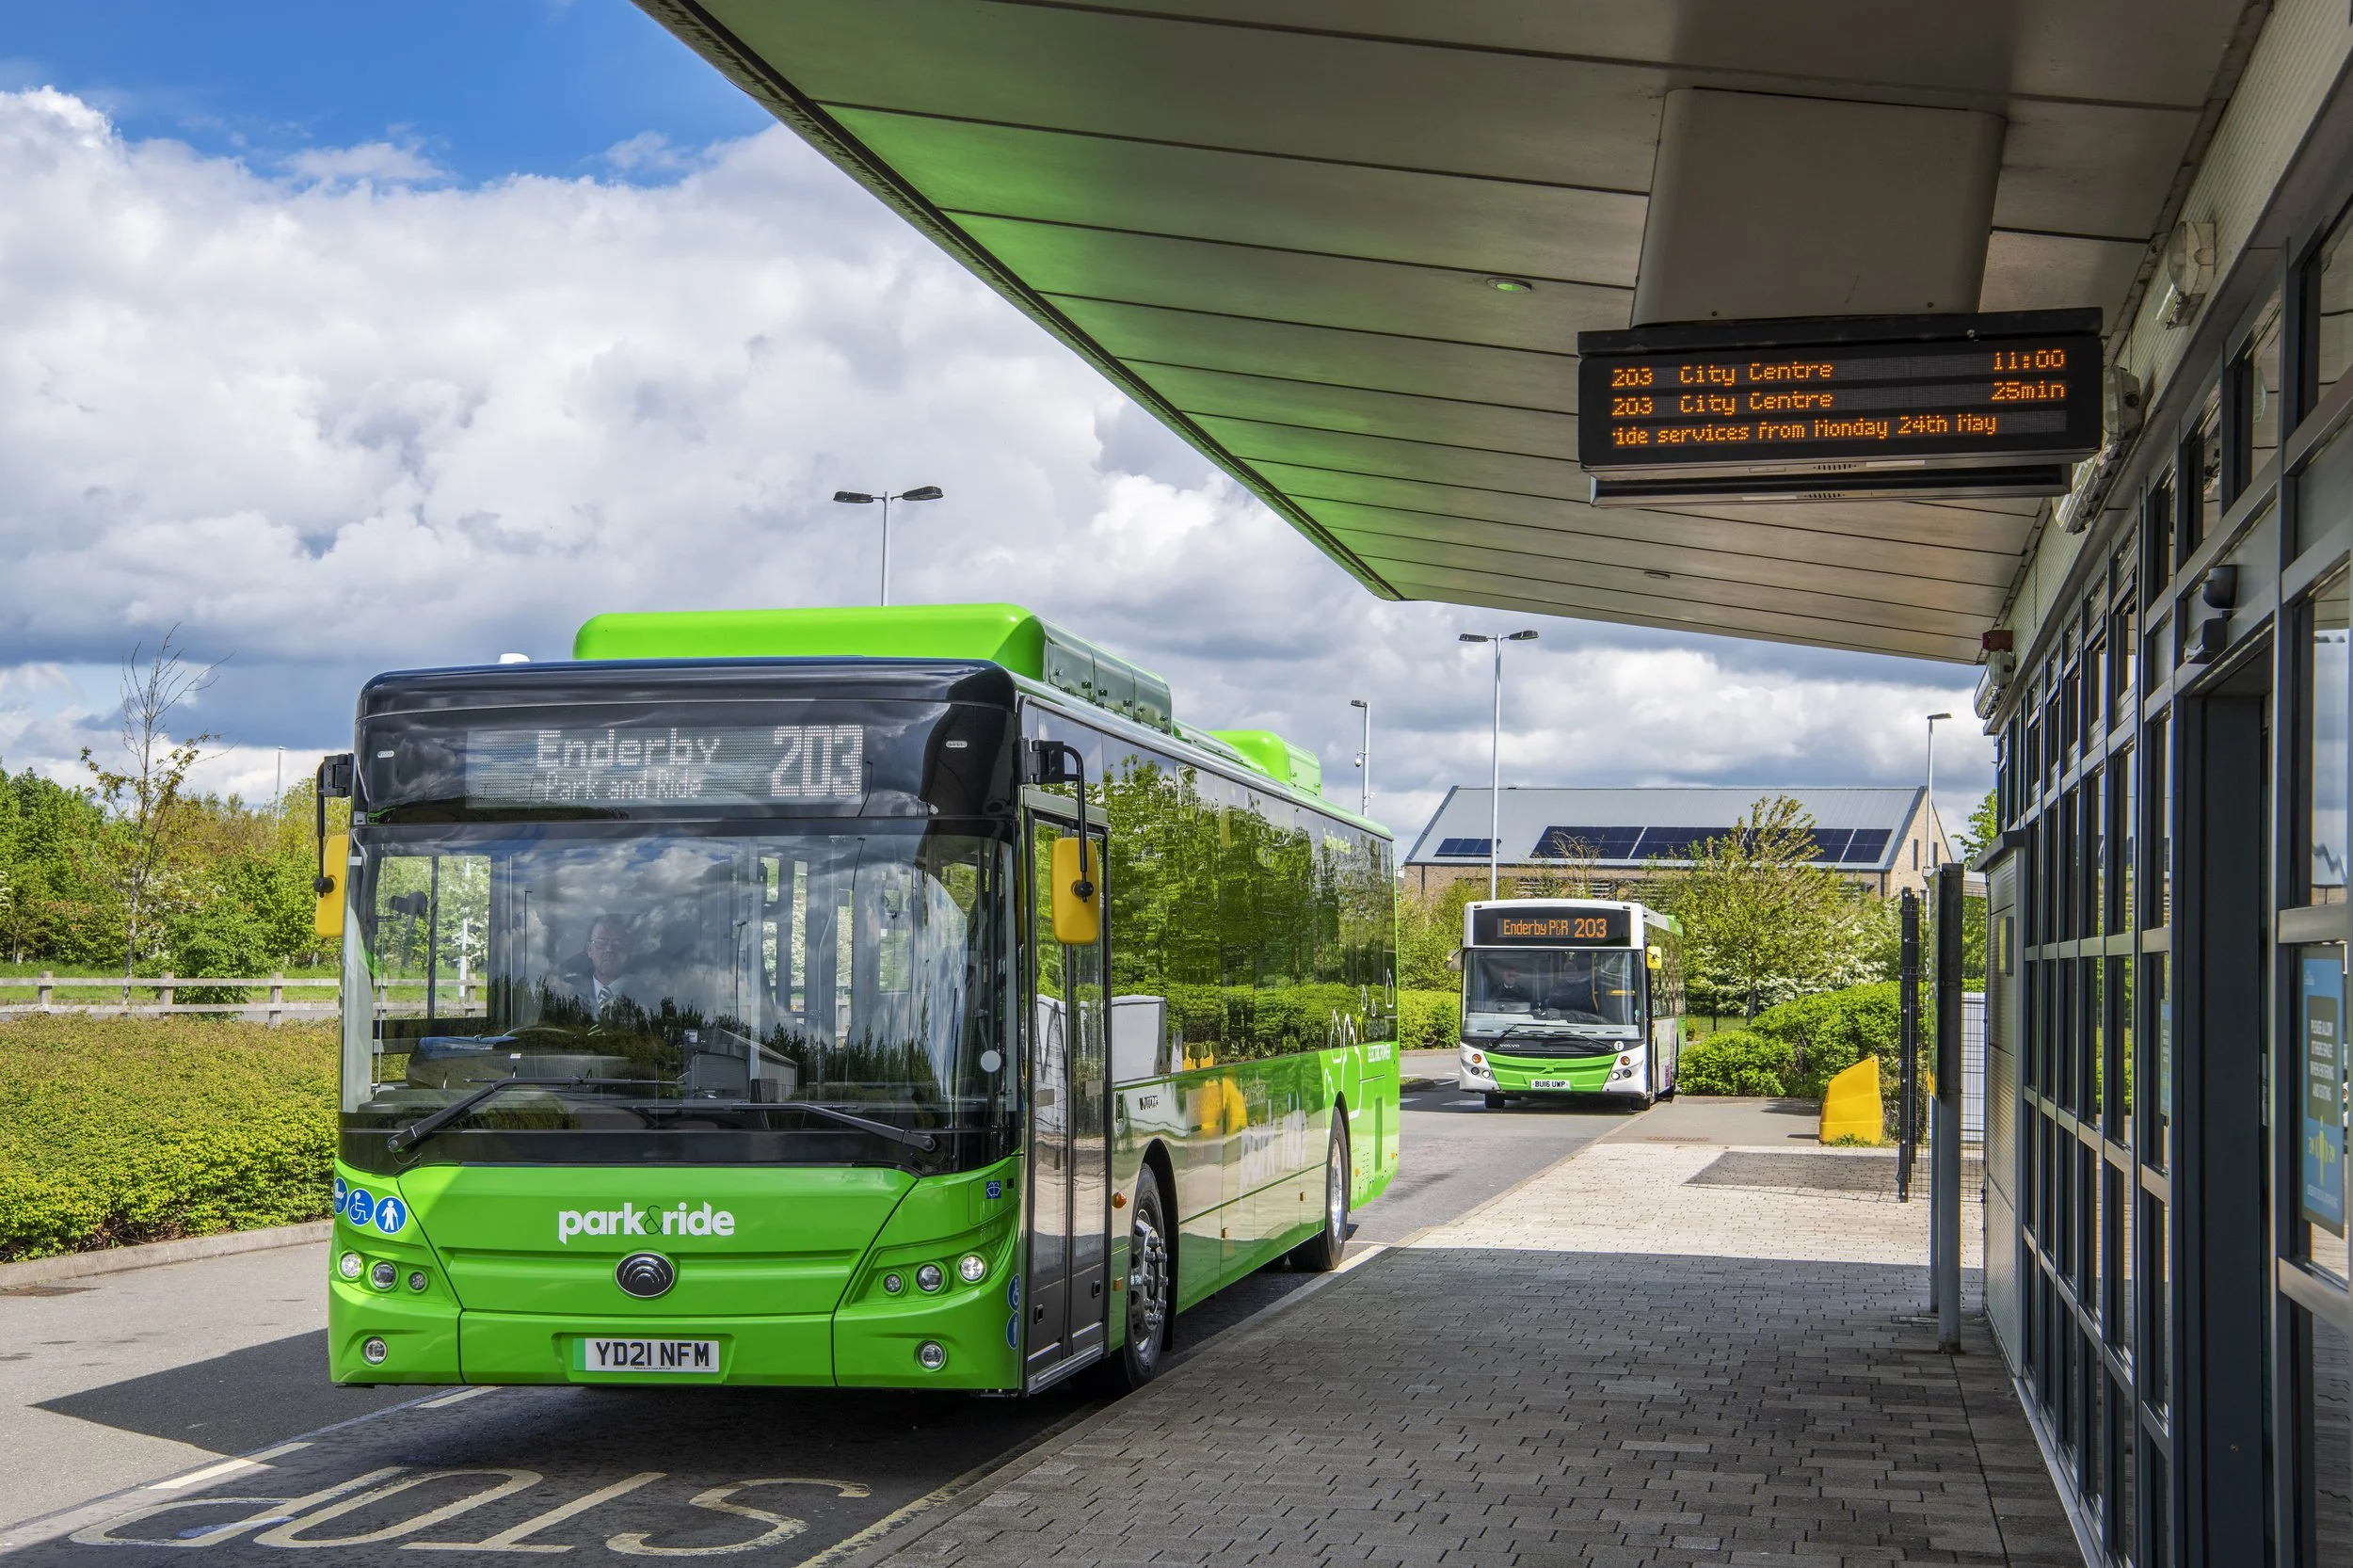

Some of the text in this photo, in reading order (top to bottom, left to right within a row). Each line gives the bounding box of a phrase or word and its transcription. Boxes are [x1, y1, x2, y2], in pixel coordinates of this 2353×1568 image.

[1612, 350, 2065, 387] 203 City Centre 11:00
[1612, 381, 2066, 416] 203 City Centre 25min
[1612, 415, 1996, 445] ide services from Monday 24th May
[537, 724, 864, 796] Enderby 203
[546, 767, 702, 800] Park and Ride
[1503, 918, 1608, 938] Enderby P&R 203
[558, 1201, 735, 1245] park&ride
[596, 1341, 710, 1368] YD21 NFM
